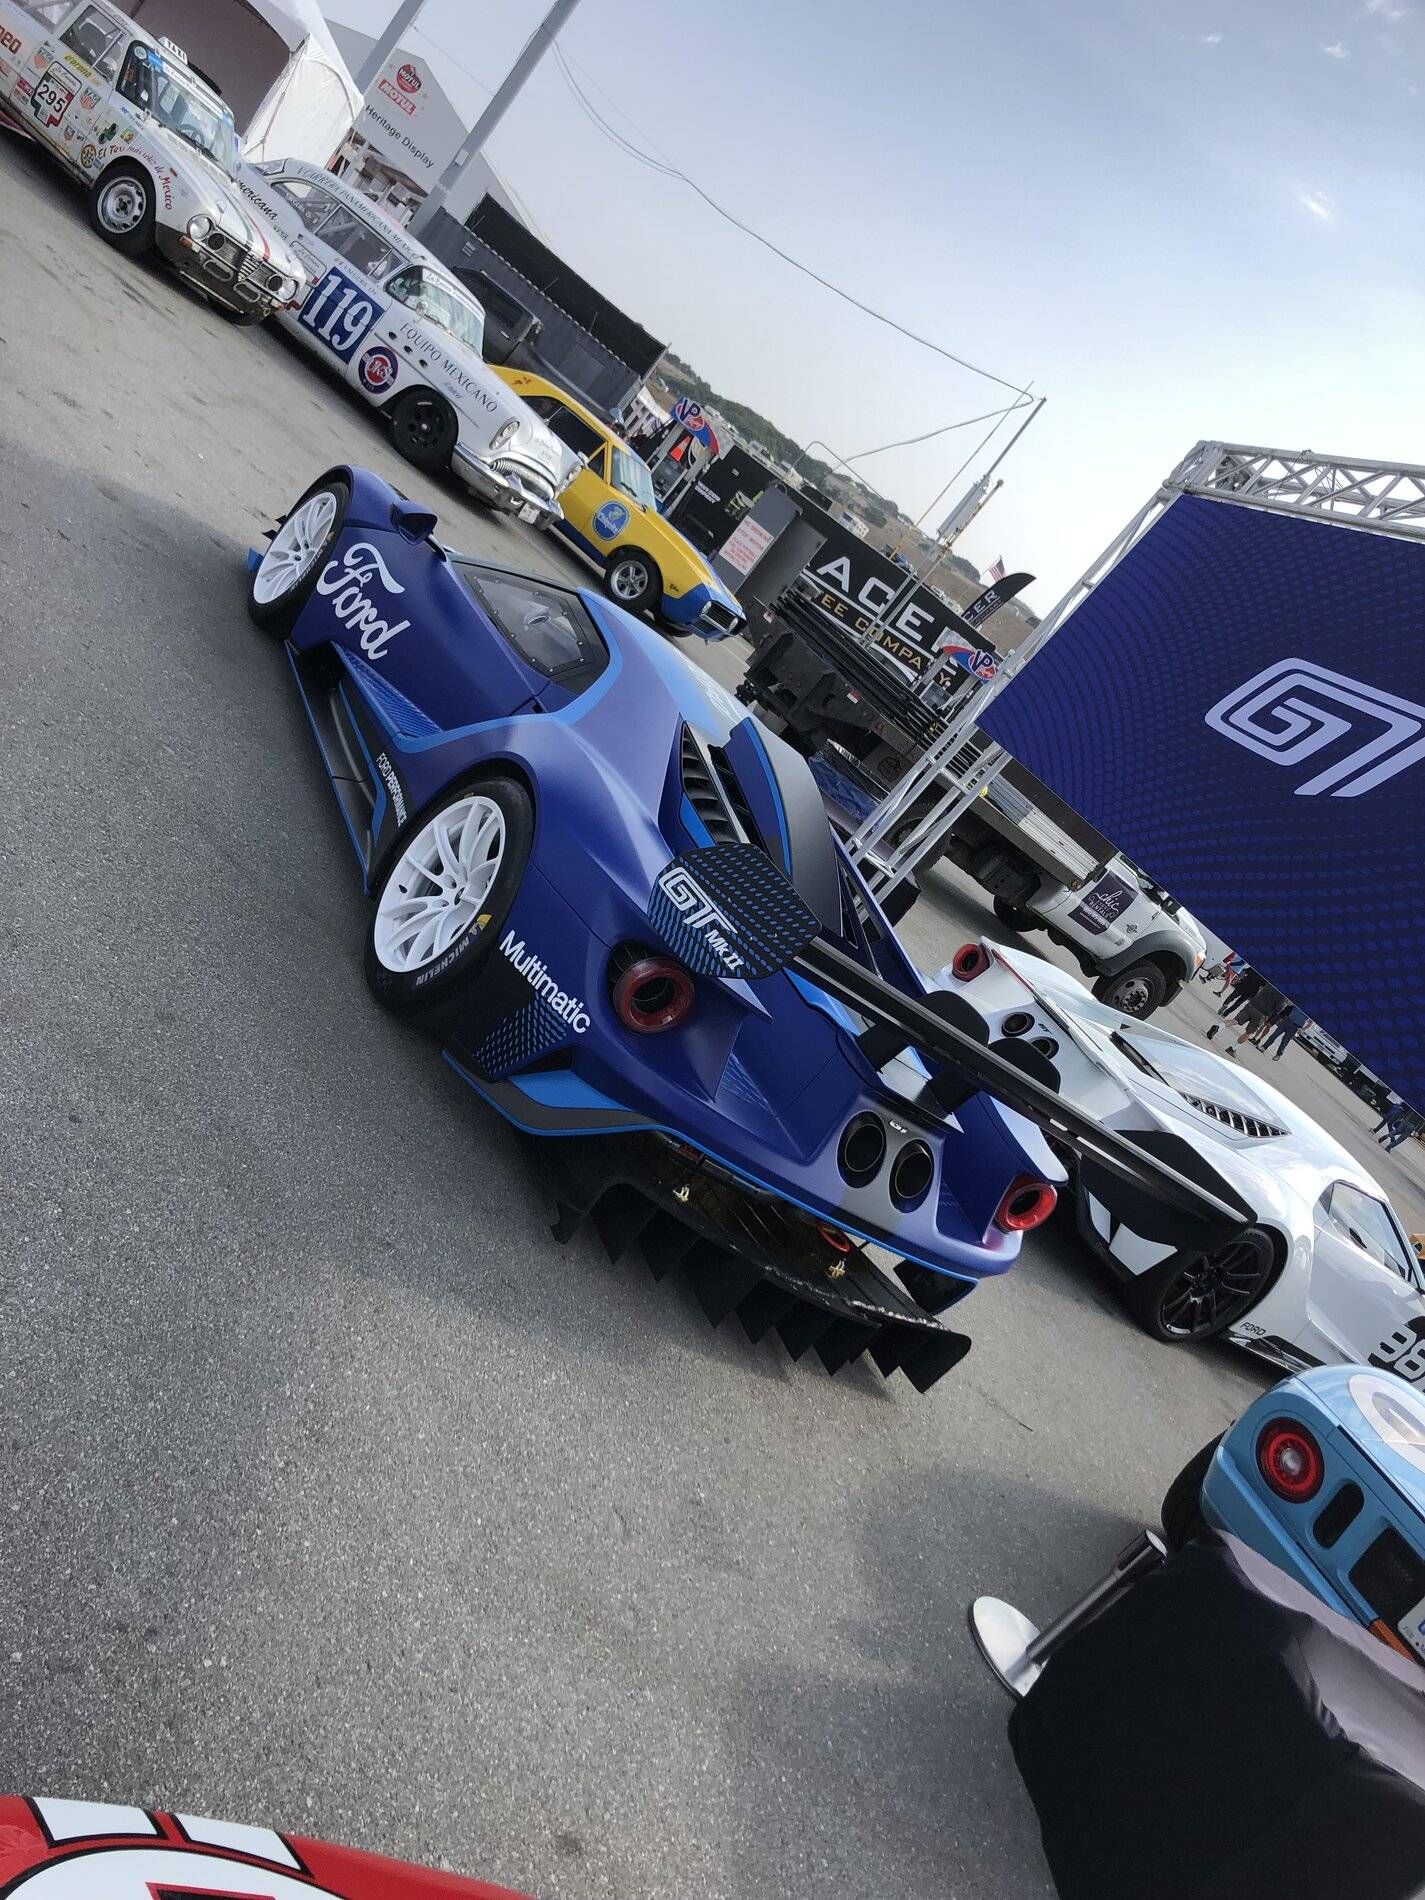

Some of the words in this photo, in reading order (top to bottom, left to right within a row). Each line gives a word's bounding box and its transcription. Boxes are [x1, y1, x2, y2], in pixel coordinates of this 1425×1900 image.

[167, 40, 186, 61] TAXI
[398, 67, 421, 91] MOTUL
[37, 84, 65, 113] 295
[365, 104, 401, 140] Heritage
[401, 137, 435, 169] Display
[302, 274, 374, 351] 119
[401, 321, 442, 362] EQUIPO
[441, 358, 498, 413] MEXICANO
[681, 397, 701, 423] VP
[316, 542, 411, 660] Ford
[963, 589, 999, 621] CER
[855, 615, 951, 688] COMPAY
[973, 650, 994, 673] VP
[375, 752, 392, 777] FORD
[385, 770, 408, 827] PERFORMANCE
[658, 866, 738, 934] GT
[415, 935, 471, 987] MICHELIN
[499, 929, 591, 1034] Multimatic
[1240, 1321, 1266, 1336] FORD
